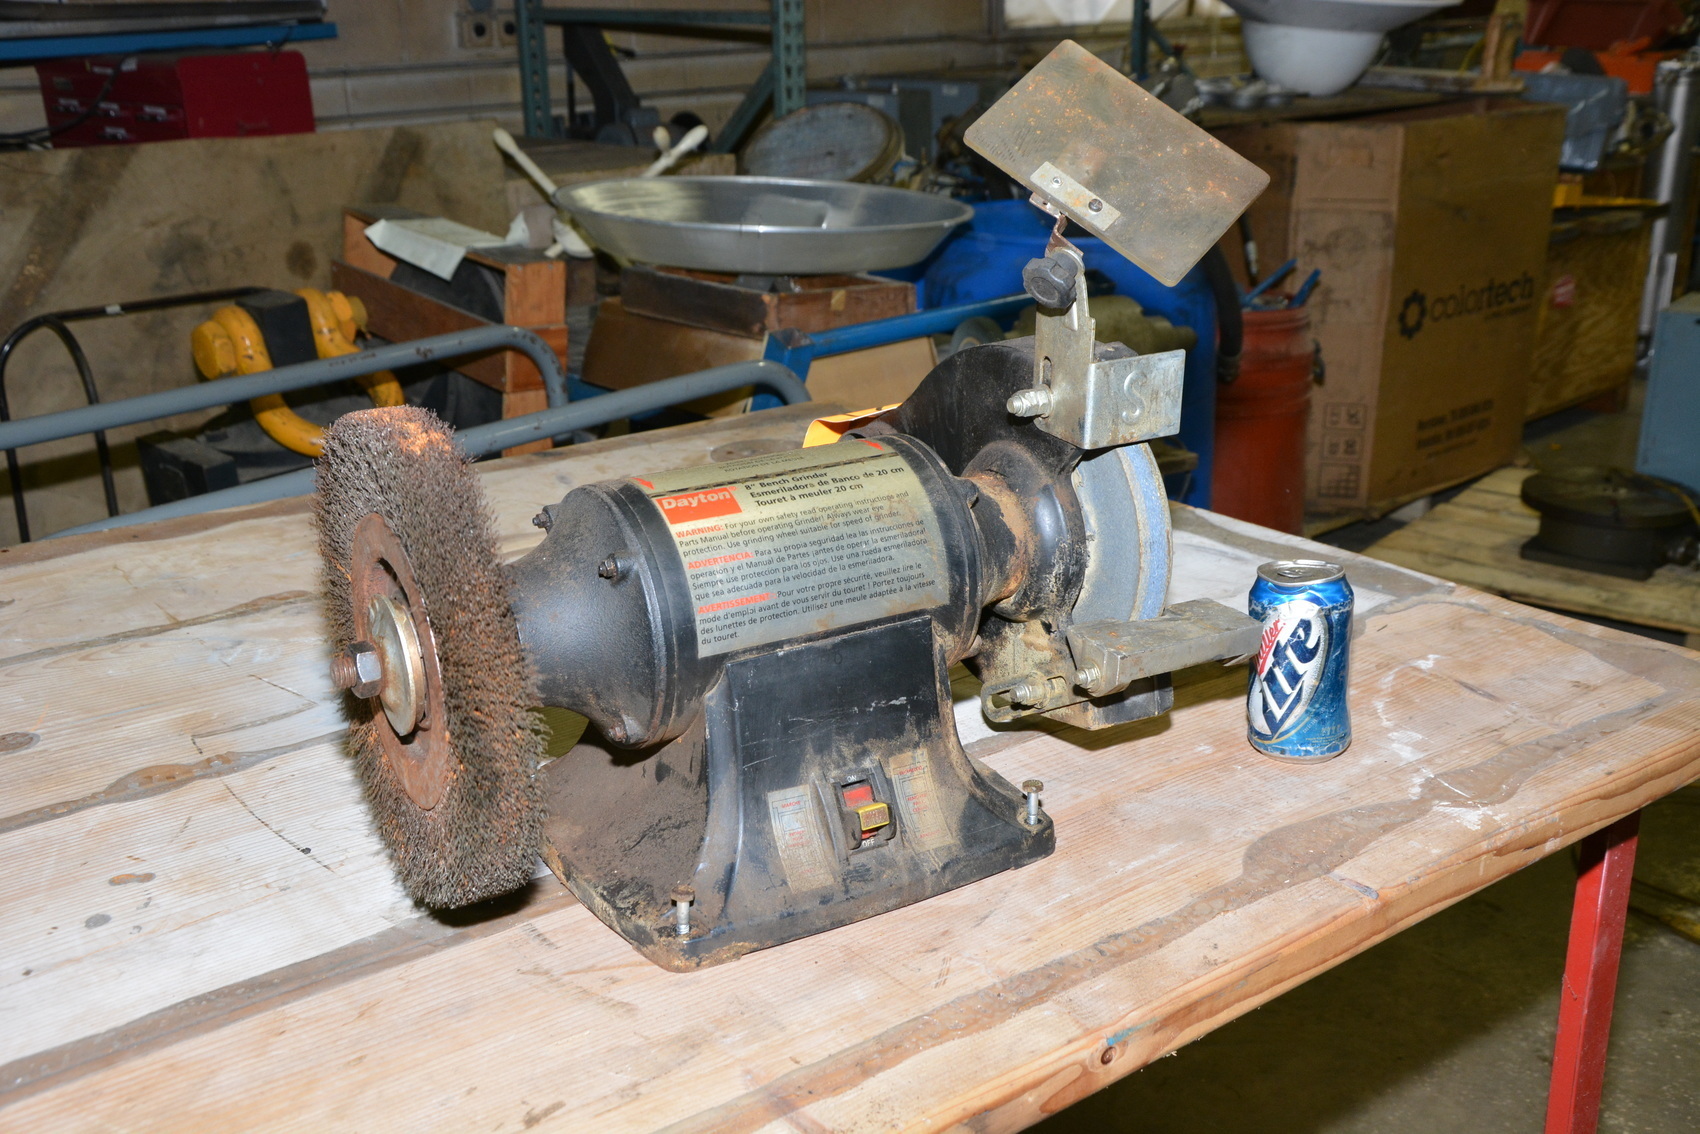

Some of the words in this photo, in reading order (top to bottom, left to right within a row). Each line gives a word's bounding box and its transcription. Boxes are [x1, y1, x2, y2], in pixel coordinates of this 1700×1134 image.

[754, 496, 788, 507] Touret
[790, 494, 796, 502] à
[798, 486, 832, 500] meuler
[850, 482, 864, 490] cm
[759, 478, 790, 488] Bench
[792, 472, 828, 482] Grinder
[831, 475, 861, 484] Banco
[876, 468, 889, 476] 20
[890, 466, 905, 474] cm
[661, 490, 731, 510] Dayton
[676, 524, 724, 538] WARNING:
[739, 520, 756, 528] your
[758, 516, 775, 524] own
[776, 510, 798, 520] safety
[800, 508, 816, 516] read
[818, 500, 854, 514] operating
[855, 494, 895, 506] instructions
[896, 490, 909, 499] and
[679, 540, 698, 548] Parts
[700, 532, 729, 544] Manual
[730, 527, 756, 538] before
[758, 520, 794, 532] operating
[794, 515, 824, 526] Grinder!
[826, 510, 852, 520] Always
[852, 508, 870, 516] wear
[872, 504, 884, 513] eye
[682, 544, 726, 558] protection.
[727, 540, 740, 548] Use
[743, 534, 775, 547] grinding
[776, 529, 798, 540] wheel
[800, 523, 828, 534] suitable
[830, 520, 840, 528] for
[842, 516, 863, 527] speed
[864, 514, 874, 522] of
[874, 510, 901, 522] grinder.
[688, 552, 754, 570] ADVERTENCIA:
[754, 549, 772, 557] Para
[774, 546, 782, 554] su
[784, 542, 808, 552] propia
[809, 534, 844, 547] seguridad
[846, 531, 858, 539] lea
[870, 522, 914, 535] instrucciones
[692, 578, 724, 590] Siempre
[726, 576, 739, 584] use
[782, 564, 798, 573] para
[800, 560, 810, 568] los
[812, 558, 830, 568] ojos.
[830, 554, 844, 562] Use
[846, 552, 860, 560] una
[862, 548, 882, 556] rueda
[884, 538, 928, 552] esmeriladora
[746, 558, 774, 569] Manual
[788, 550, 810, 560] Partes
[836, 543, 844, 551] de
[846, 539, 870, 551] operar
[694, 594, 710, 602] que
[726, 582, 763, 594] adecuada
[764, 578, 782, 587] para
[792, 567, 826, 580] velocidad
[848, 554, 894, 570] esmeriladora.
[777, 590, 794, 598] Pour
[796, 586, 816, 594] votre
[818, 581, 841, 591] propre
[843, 571, 873, 584] sécurité,
[874, 566, 900, 578] veuillez
[902, 564, 914, 572] lire
[700, 615, 720, 625] mode
[724, 608, 756, 620] d'emploi
[758, 604, 780, 612] avant
[781, 600, 790, 608] de
[810, 592, 830, 602] servir
[832, 588, 842, 597] du
[844, 584, 866, 594] touret
[872, 578, 894, 588] Portez
[896, 572, 925, 584] toujours
[700, 627, 714, 635] des
[716, 620, 746, 632] lunettes
[748, 617, 758, 626] de
[760, 608, 800, 623] protection.
[802, 600, 828, 614] Utilisez
[830, 600, 844, 608] une
[845, 594, 867, 604] meule
[869, 588, 898, 600] adaptée
[913, 579, 936, 590] vitesse
[702, 637, 712, 645] du
[714, 632, 740, 642] touret.
[1252, 619, 1282, 675] iller
[846, 775, 857, 783] ON
[862, 838, 875, 848] OFF
